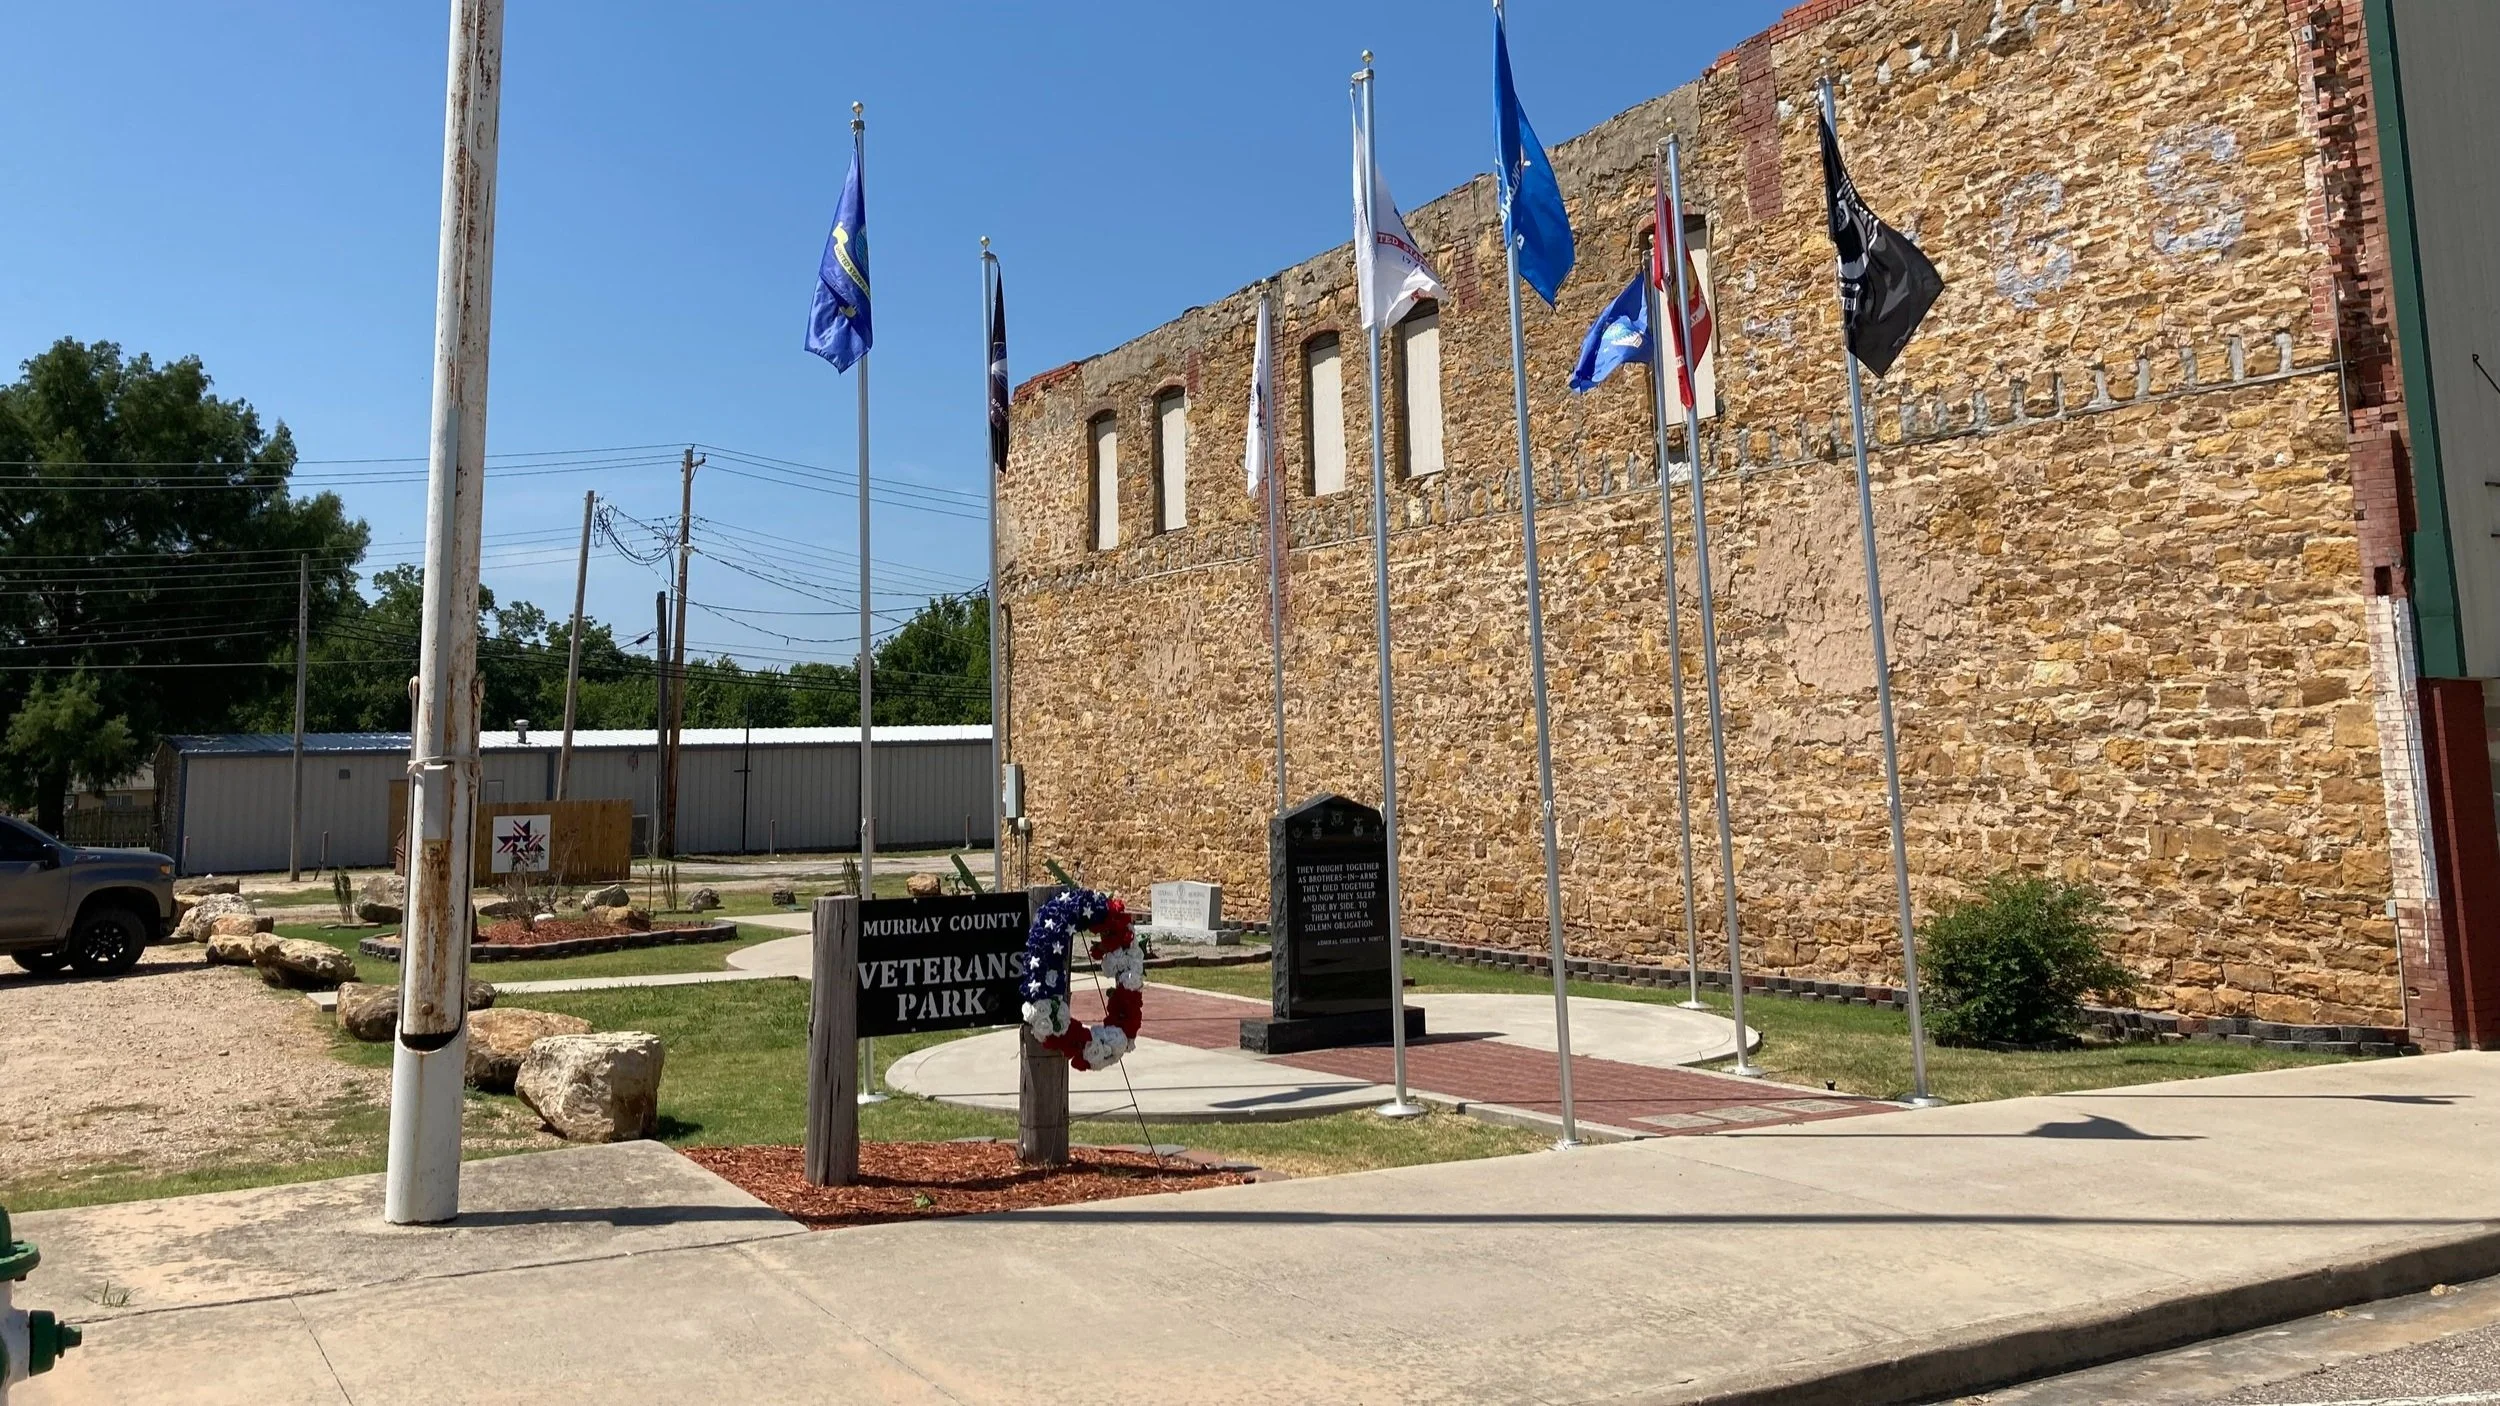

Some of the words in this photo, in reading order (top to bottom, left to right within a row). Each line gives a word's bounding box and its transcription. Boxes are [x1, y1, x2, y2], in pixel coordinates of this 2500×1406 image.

[1296, 866, 1314, 874] THEY
[1316, 865, 1343, 873] FOUGHT
[1345, 863, 1379, 872] TOGETHER
[1298, 876, 1307, 884] AS
[1302, 885, 1320, 893] THEY
[1322, 884, 1339, 892] DIED
[1340, 882, 1375, 891] TOGETHER
[1302, 895, 1317, 903] AND
[1320, 894, 1334, 902] NOW
[1337, 893, 1354, 901] THEY
[1356, 891, 1376, 899] SLEEP
[1311, 904, 1326, 912] SIDE
[1311, 914, 1330, 922] THEM
[1344, 911, 1361, 919] HAVE
[863, 916, 943, 937] MURRAY
[949, 911, 1022, 932] COUNTY
[1304, 923, 1332, 932] SOLEMN
[1334, 921, 1373, 930] OBLIGATION
[858, 951, 1026, 990] VETERANS
[897, 987, 986, 1021] PARK
